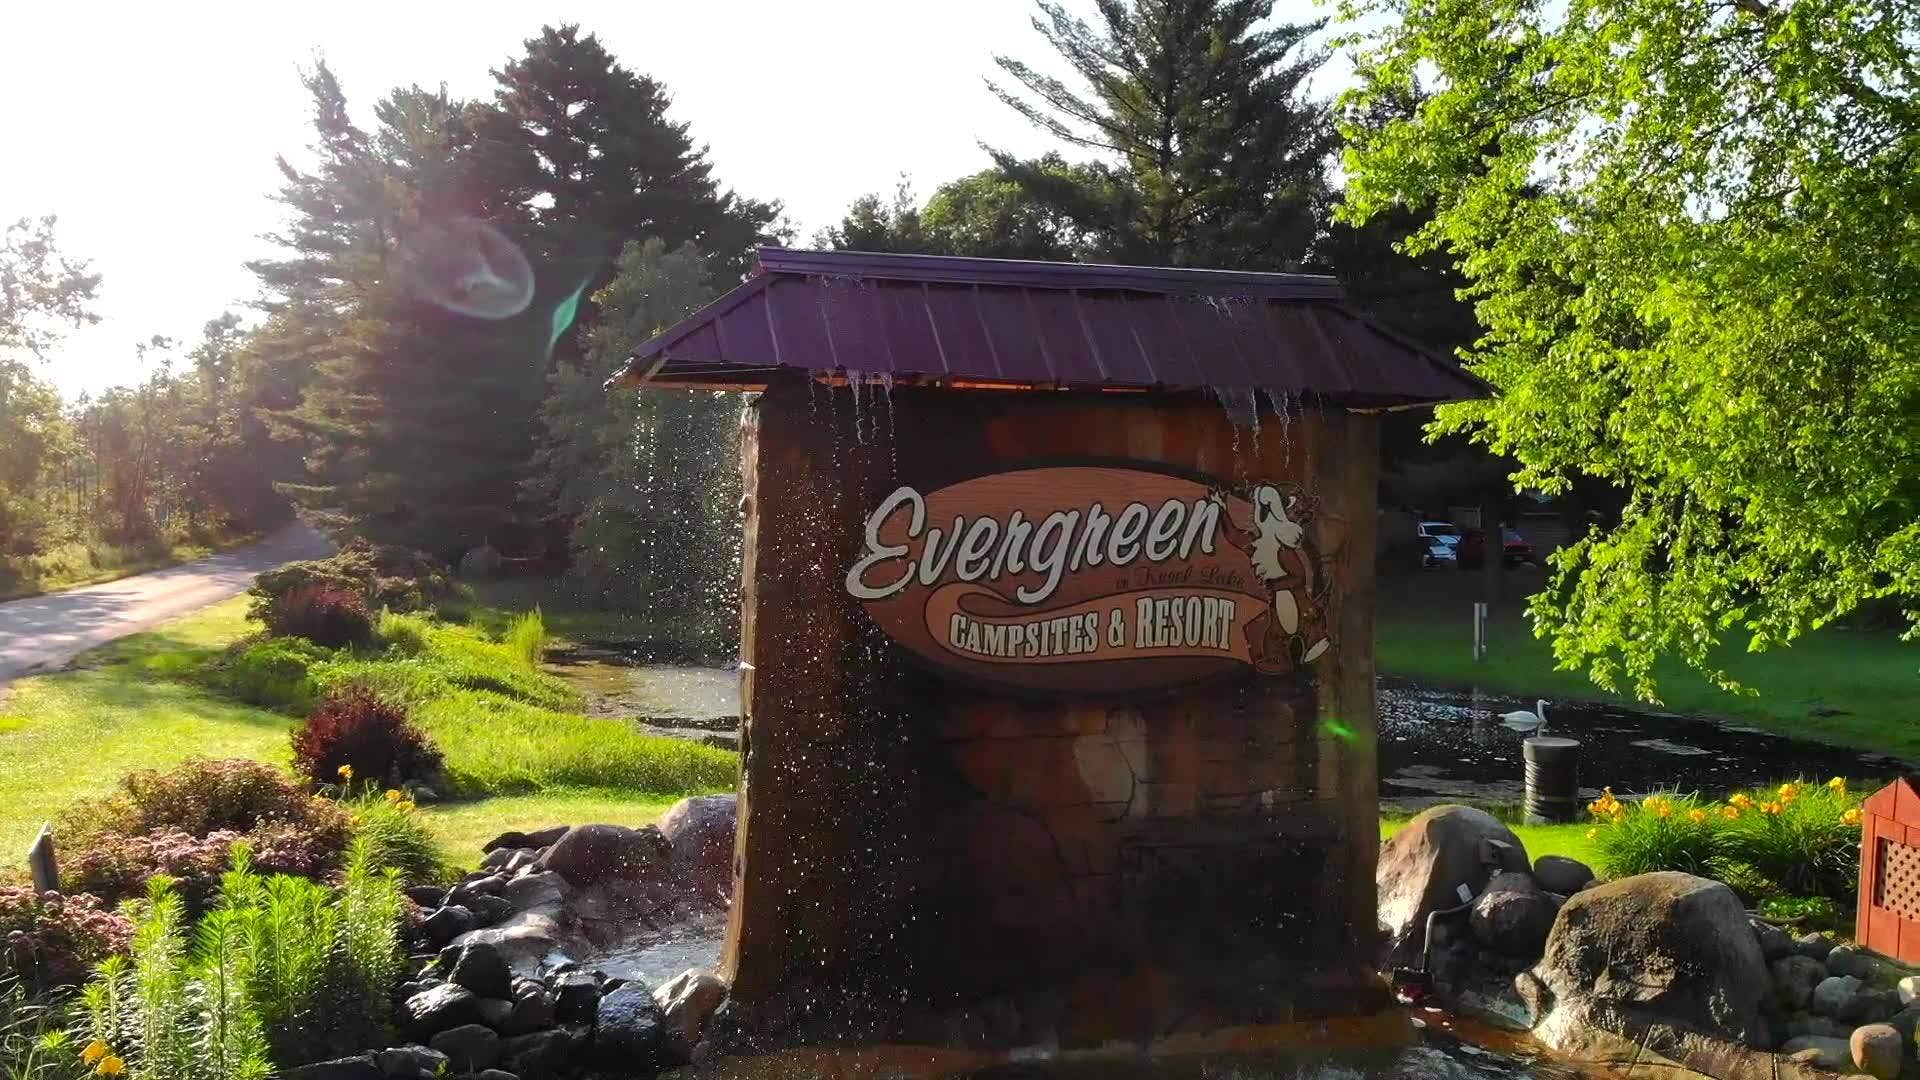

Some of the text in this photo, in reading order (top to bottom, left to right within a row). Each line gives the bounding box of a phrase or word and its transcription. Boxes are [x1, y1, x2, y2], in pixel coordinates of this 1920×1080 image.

[845, 486, 1219, 603] Evergreen
[949, 597, 1235, 658] CAMPSITES & RESORT
